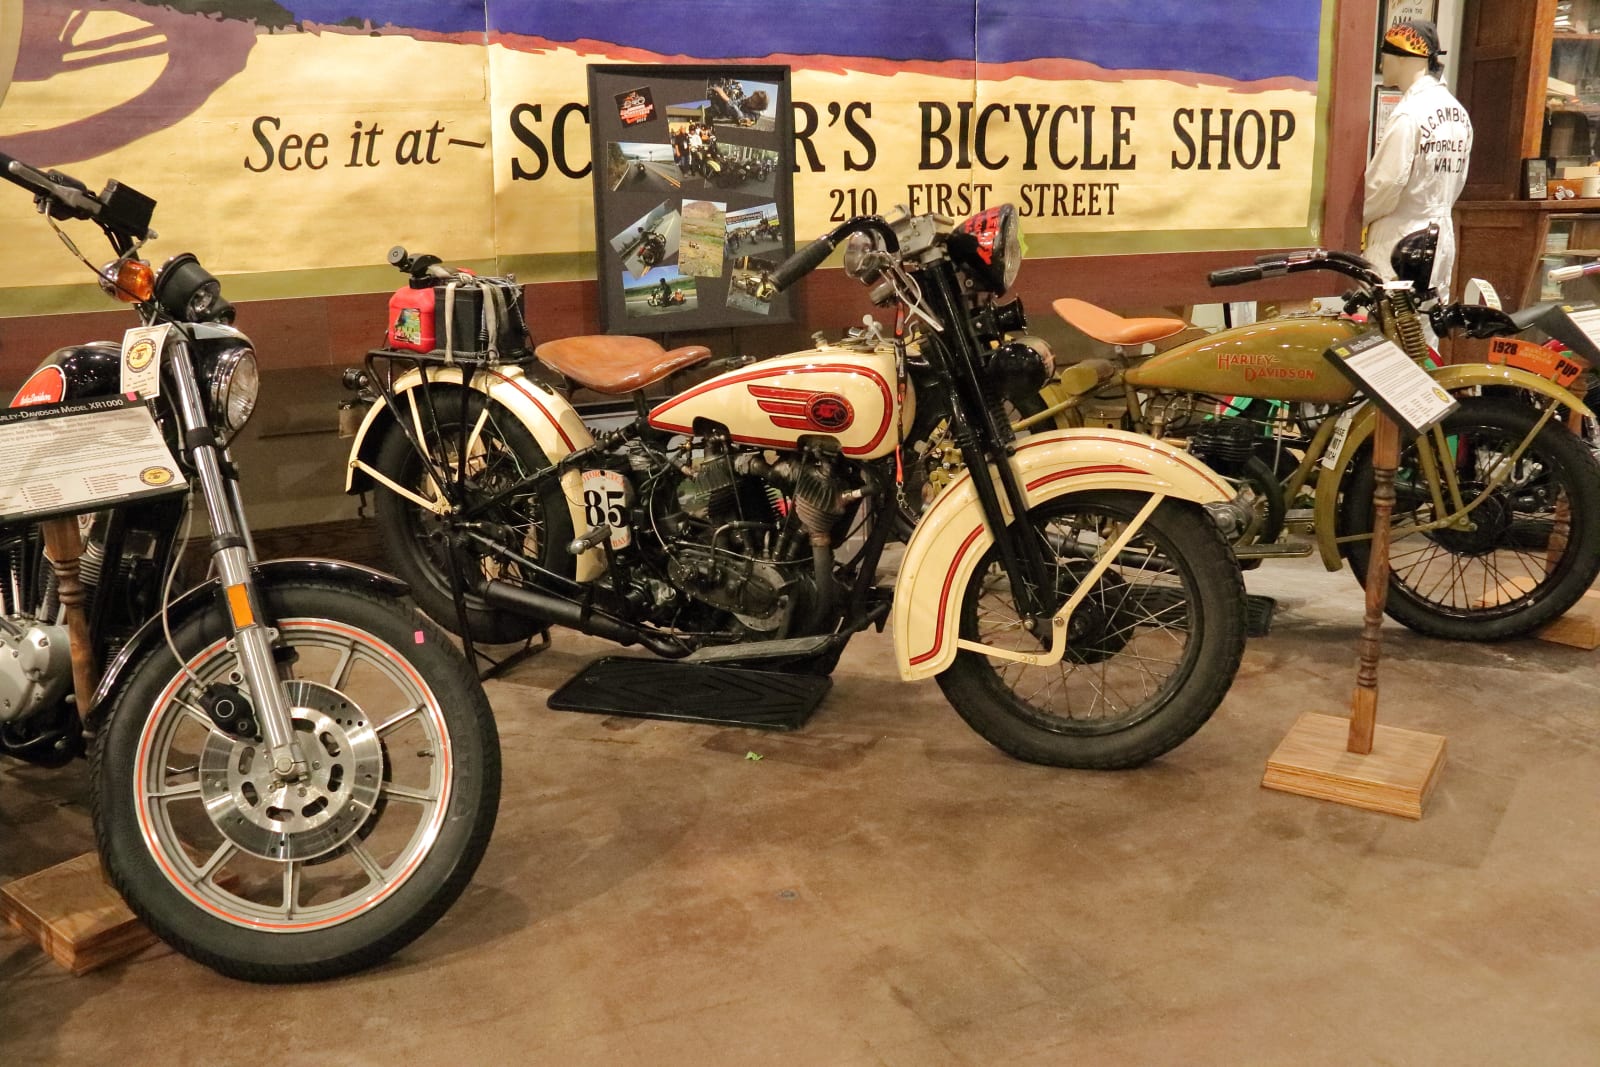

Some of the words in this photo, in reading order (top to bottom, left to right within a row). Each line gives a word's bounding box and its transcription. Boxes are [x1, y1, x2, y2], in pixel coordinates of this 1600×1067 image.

[244, 115, 329, 172] See
[344, 121, 383, 168] it
[918, 102, 1136, 171] BICYCLE
[1172, 108, 1295, 170] SHOP
[829, 189, 877, 222] 210
[908, 184, 993, 217] FIRST
[1018, 183, 1120, 217] STREET
[1244, 367, 1316, 382] DAVIDSON
[1492, 340, 1518, 356] 1928
[1554, 359, 1579, 378] PUP
[89, 398, 124, 410] XR1000
[584, 490, 628, 528] 85
